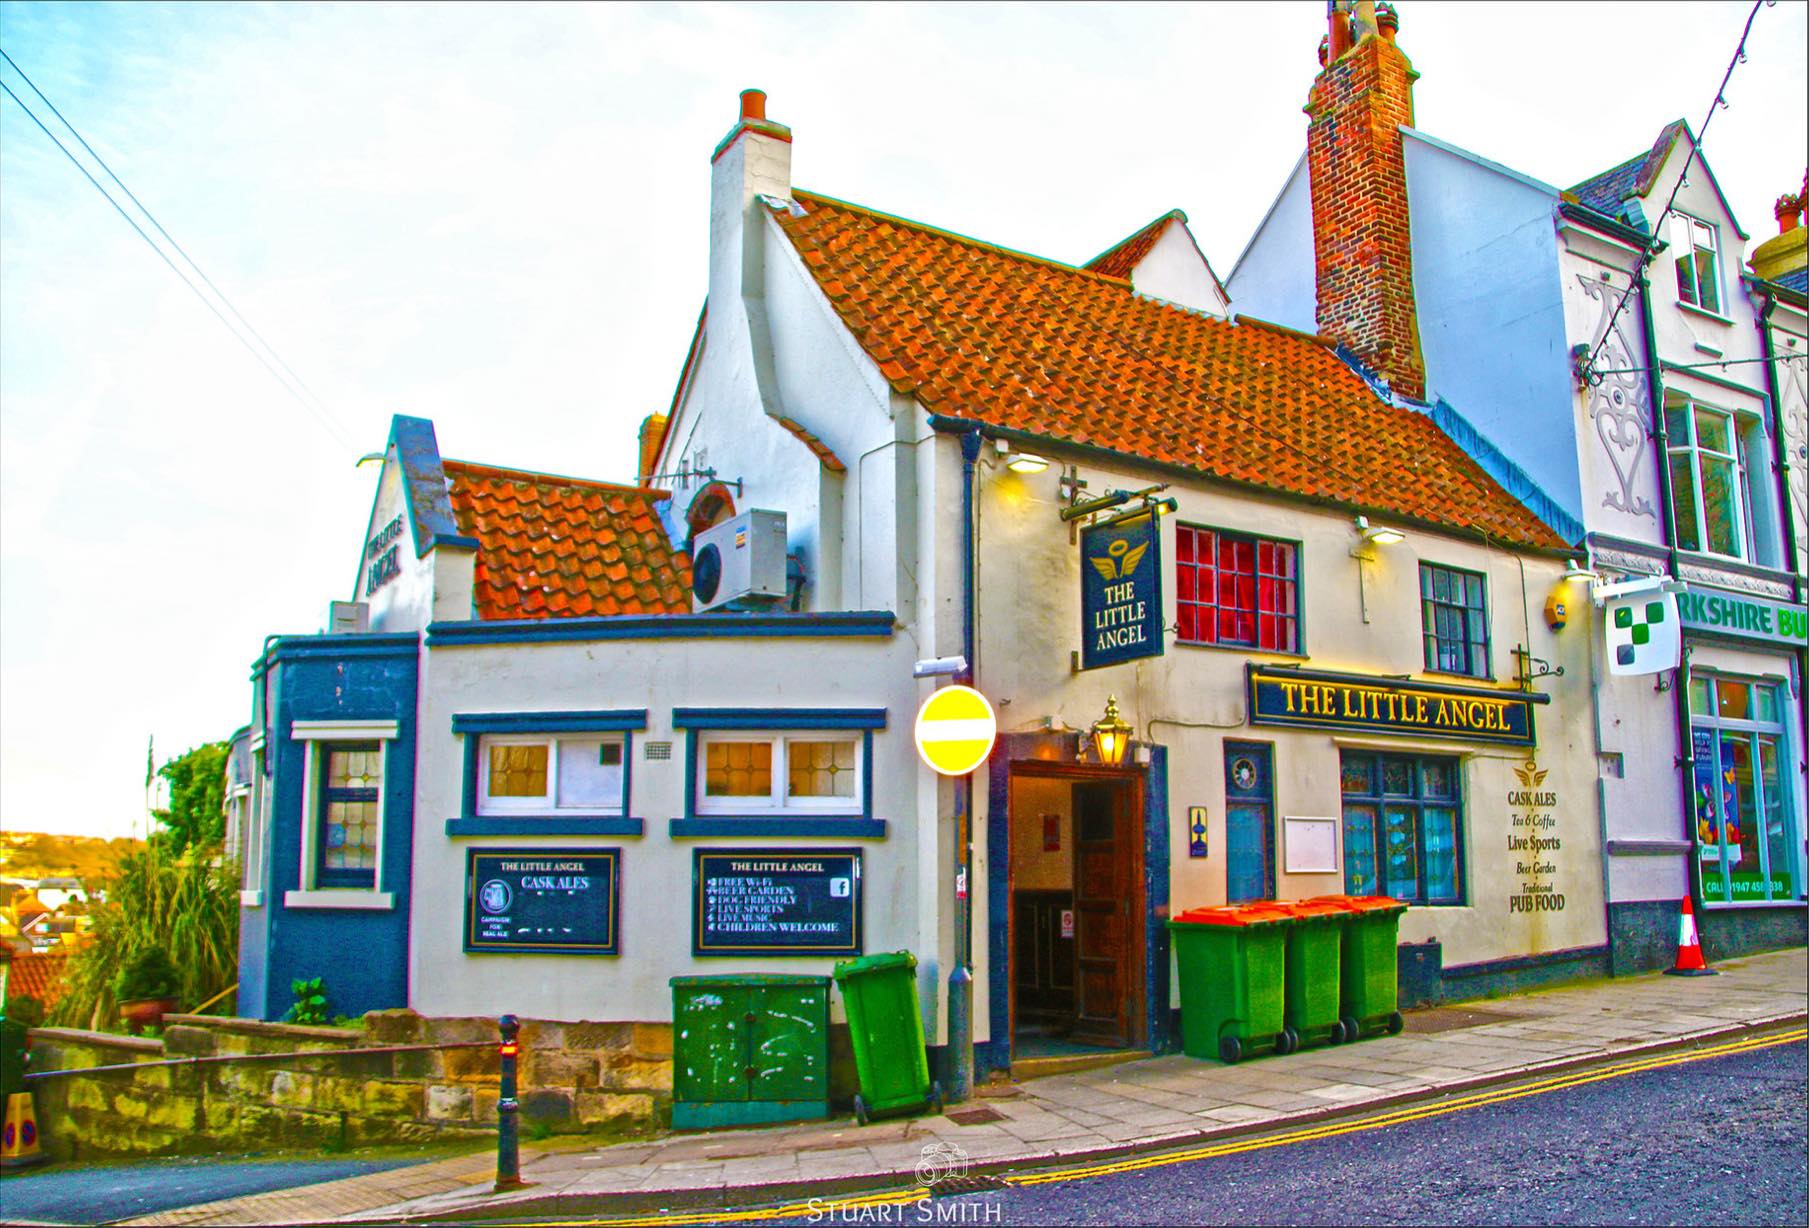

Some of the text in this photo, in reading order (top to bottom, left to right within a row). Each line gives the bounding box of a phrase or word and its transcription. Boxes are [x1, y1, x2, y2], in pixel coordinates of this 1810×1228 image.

[1104, 581, 1135, 605] THE
[1095, 601, 1146, 629] LITTLE
[1096, 624, 1147, 651] ANGEL
[1280, 683, 1511, 731] THE LITTLE ANGEL
[1507, 791, 1557, 806] CASK ALES
[1511, 814, 1523, 826] Tea
[1532, 814, 1556, 831] Coffee
[1507, 834, 1561, 854] Live Sports
[500, 862, 585, 872] THE LITTLE ANGEL
[730, 862, 825, 872] THE LITTLE ANGEL
[1516, 861, 1556, 874] Beer Garden
[520, 876, 590, 889] CASK ALES
[718, 878, 744, 886] FREE
[1521, 882, 1553, 894] Traditional
[1706, 881, 1723, 893] CALL
[718, 886, 795, 895] BEER GARDEN
[718, 895, 798, 905] DOG FRIENDLY
[1509, 893, 1565, 914] PUB FOOD
[717, 904, 784, 913] LIVE SPORTS
[717, 913, 740, 922] LIVE
[717, 922, 839, 932] CHILDREN WELCOME
